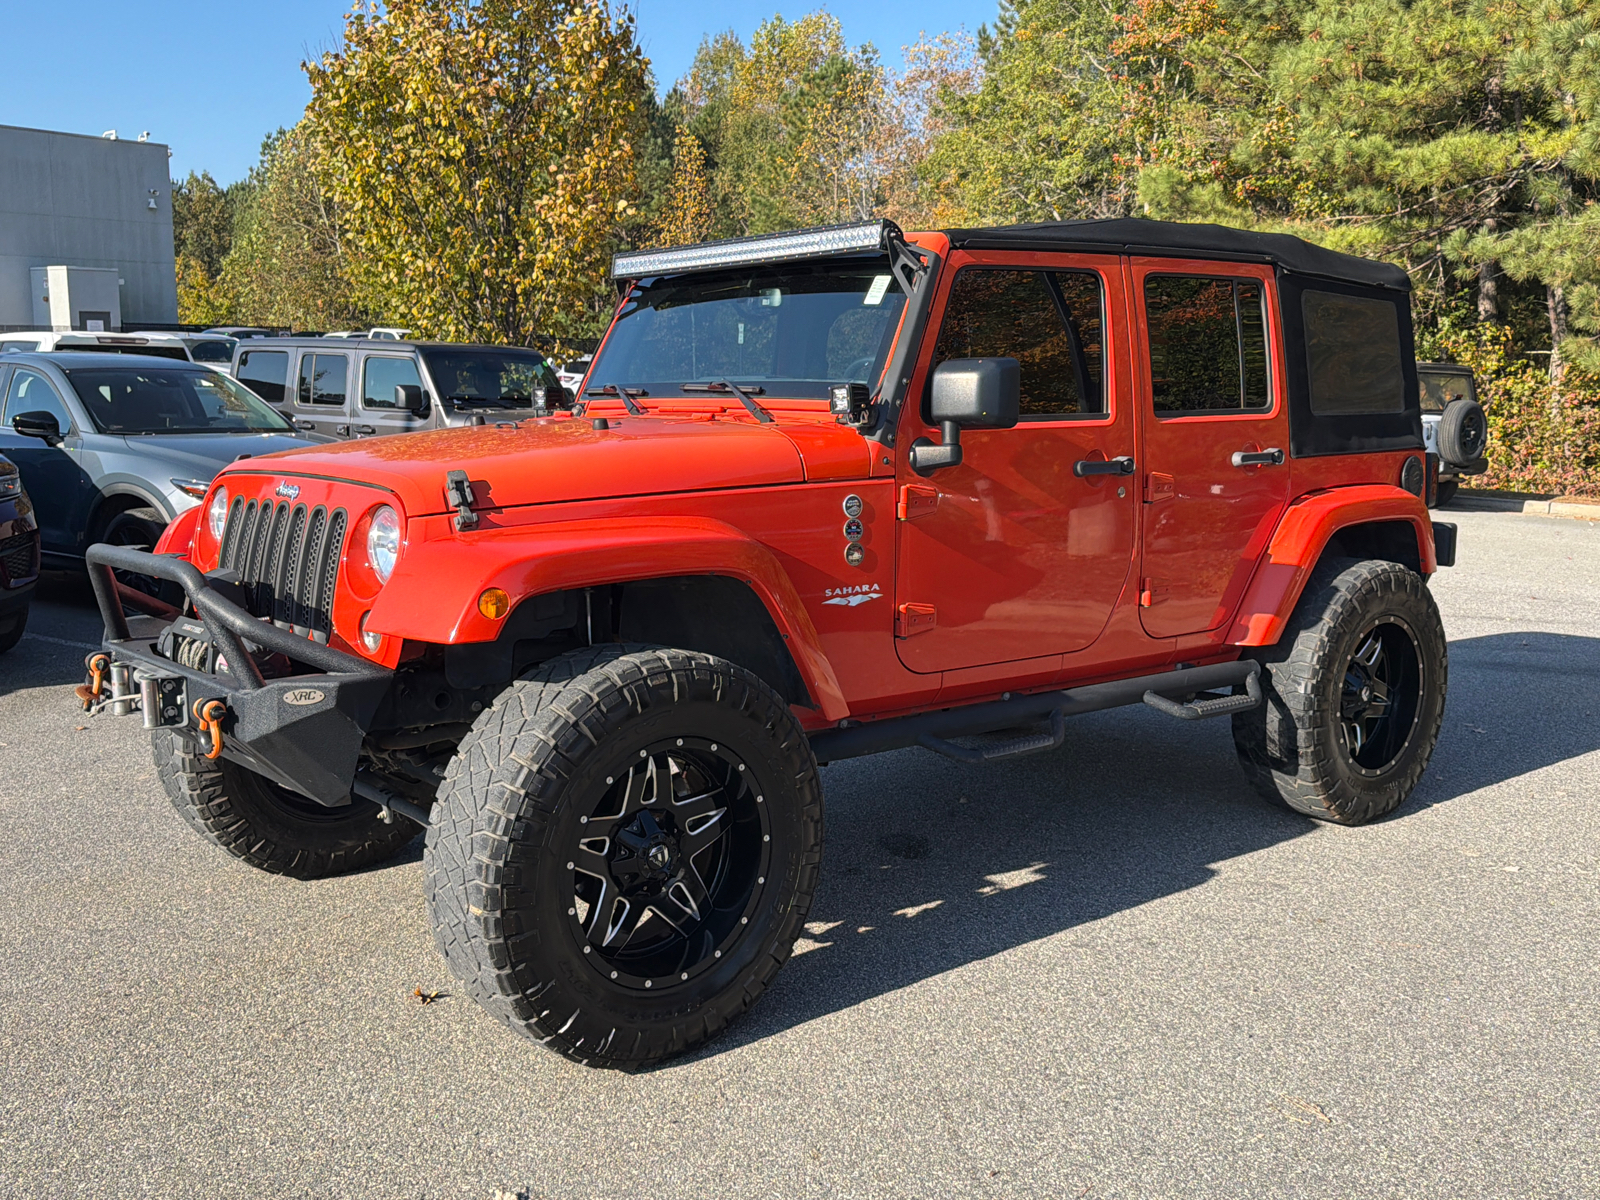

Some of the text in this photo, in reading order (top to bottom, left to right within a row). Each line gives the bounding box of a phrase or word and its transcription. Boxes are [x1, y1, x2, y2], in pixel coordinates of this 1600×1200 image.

[275, 480, 300, 501] Jeep
[825, 583, 881, 597] SAHARA
[290, 690, 317, 702] XRC
